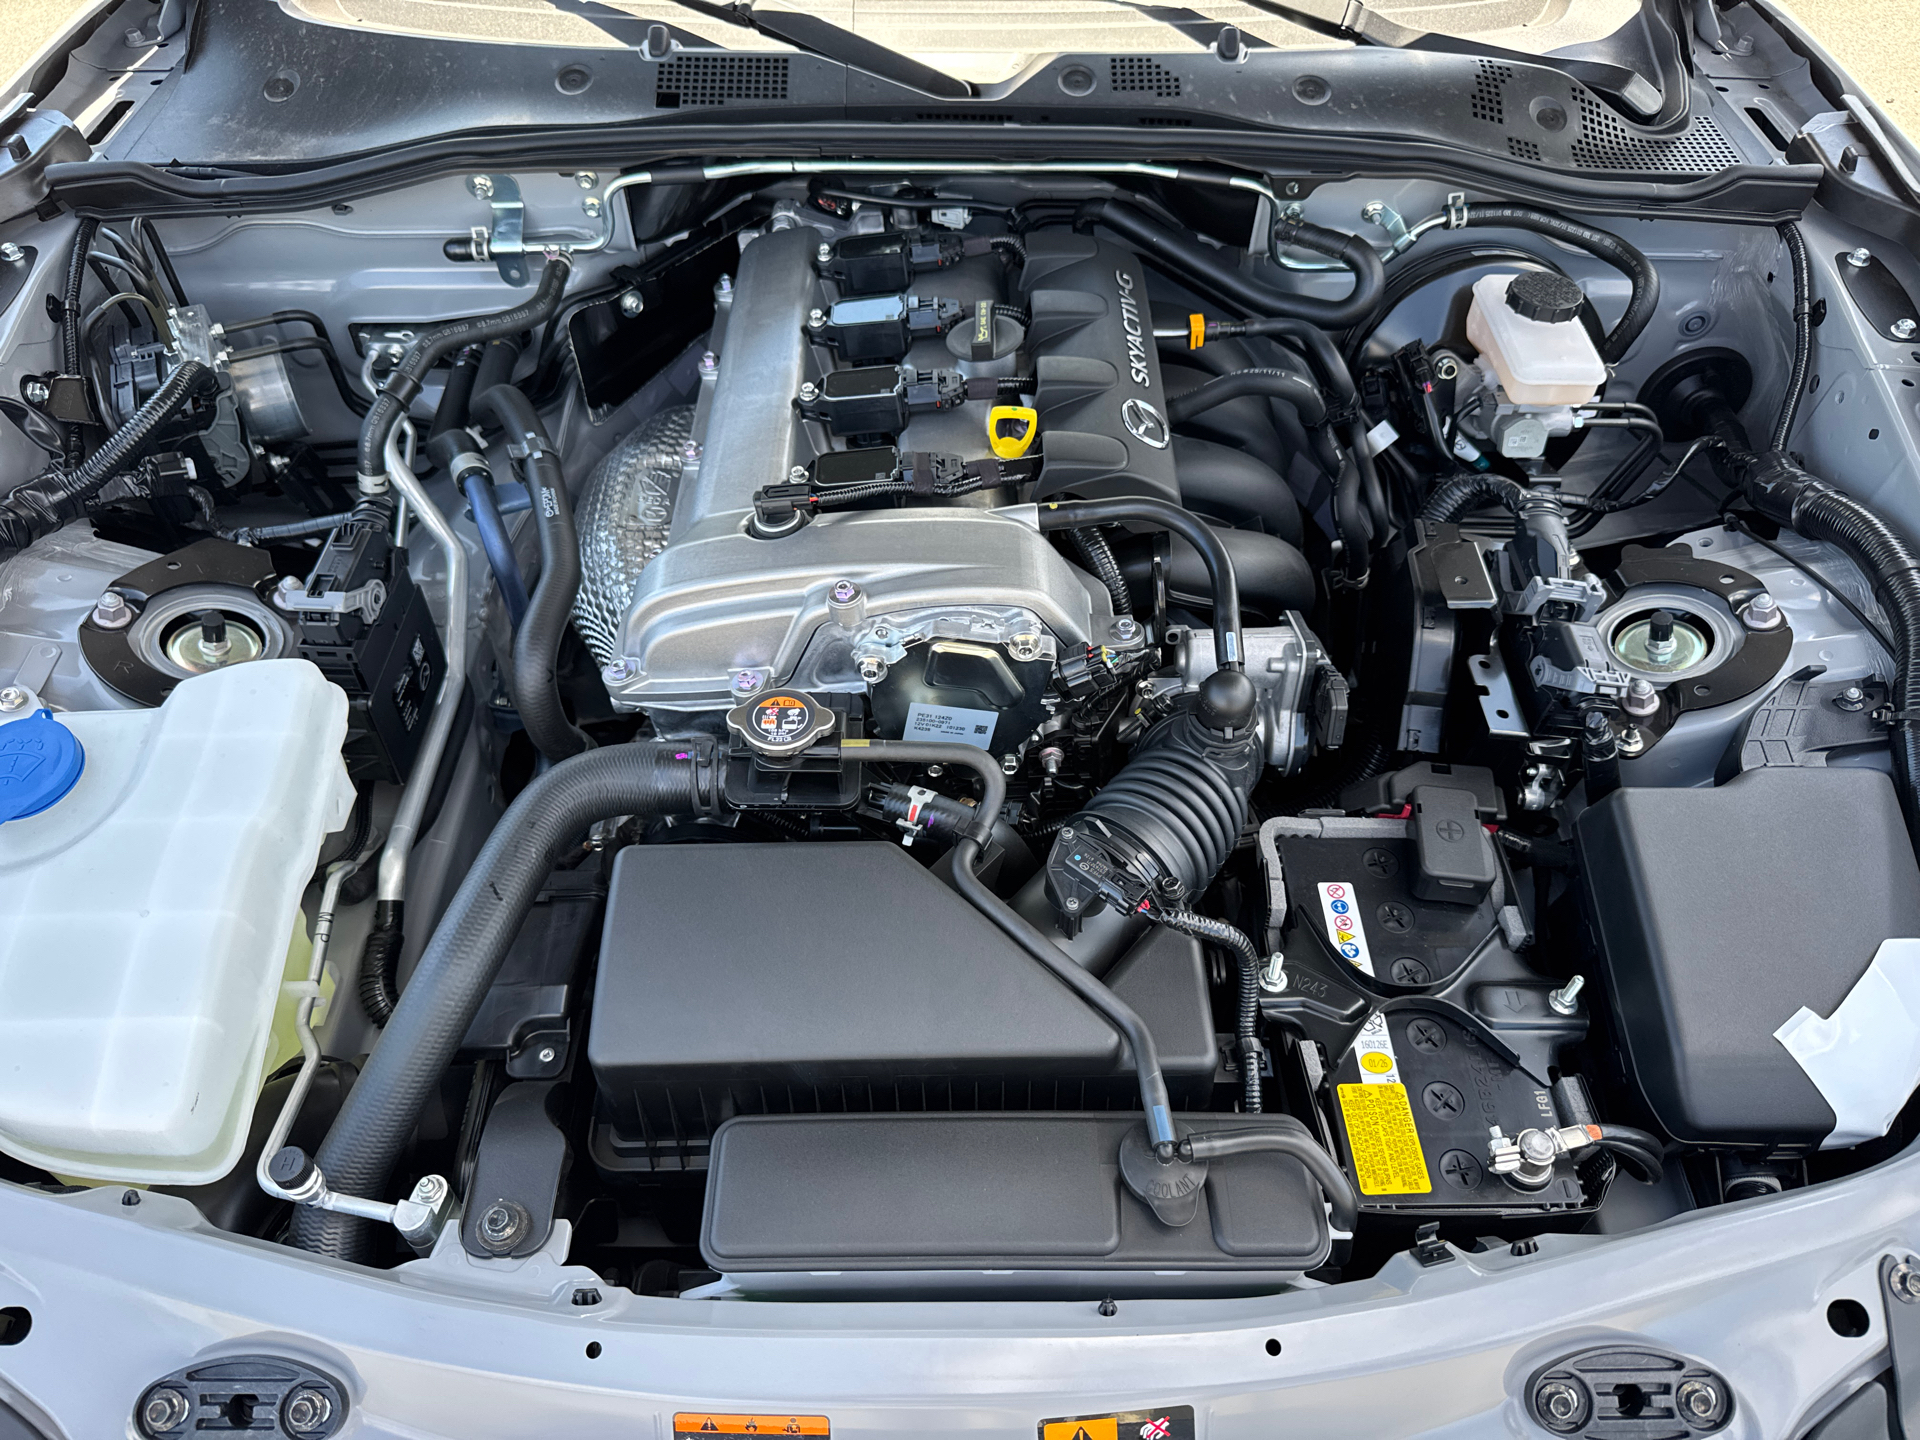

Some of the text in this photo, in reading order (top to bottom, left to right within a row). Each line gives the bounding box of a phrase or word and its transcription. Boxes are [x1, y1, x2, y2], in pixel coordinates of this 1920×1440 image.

[1116, 270, 1150, 388] SKYACTIV-G
[1368, 1058, 1389, 1068] 01/26
[1347, 1099, 1356, 1111] KEEP
[1373, 1097, 1383, 1109] KEEP
[1350, 1111, 1359, 1121] OUT
[1365, 1099, 1380, 1125] POISON
[1372, 1127, 1383, 1146] CAUSES
[1380, 1123, 1390, 1136] CAPS
[1398, 1100, 1414, 1133] DANGER
[1414, 1162, 1425, 1179] GASES
[1358, 1146, 1367, 1154] OF
[1377, 1147, 1388, 1166] SEVERE
[1387, 1152, 1396, 1162] AND
[1360, 1154, 1373, 1178] CHILDREN
[1390, 1163, 1400, 1178] LEVEL
[1145, 1173, 1196, 1198] COOLANT
